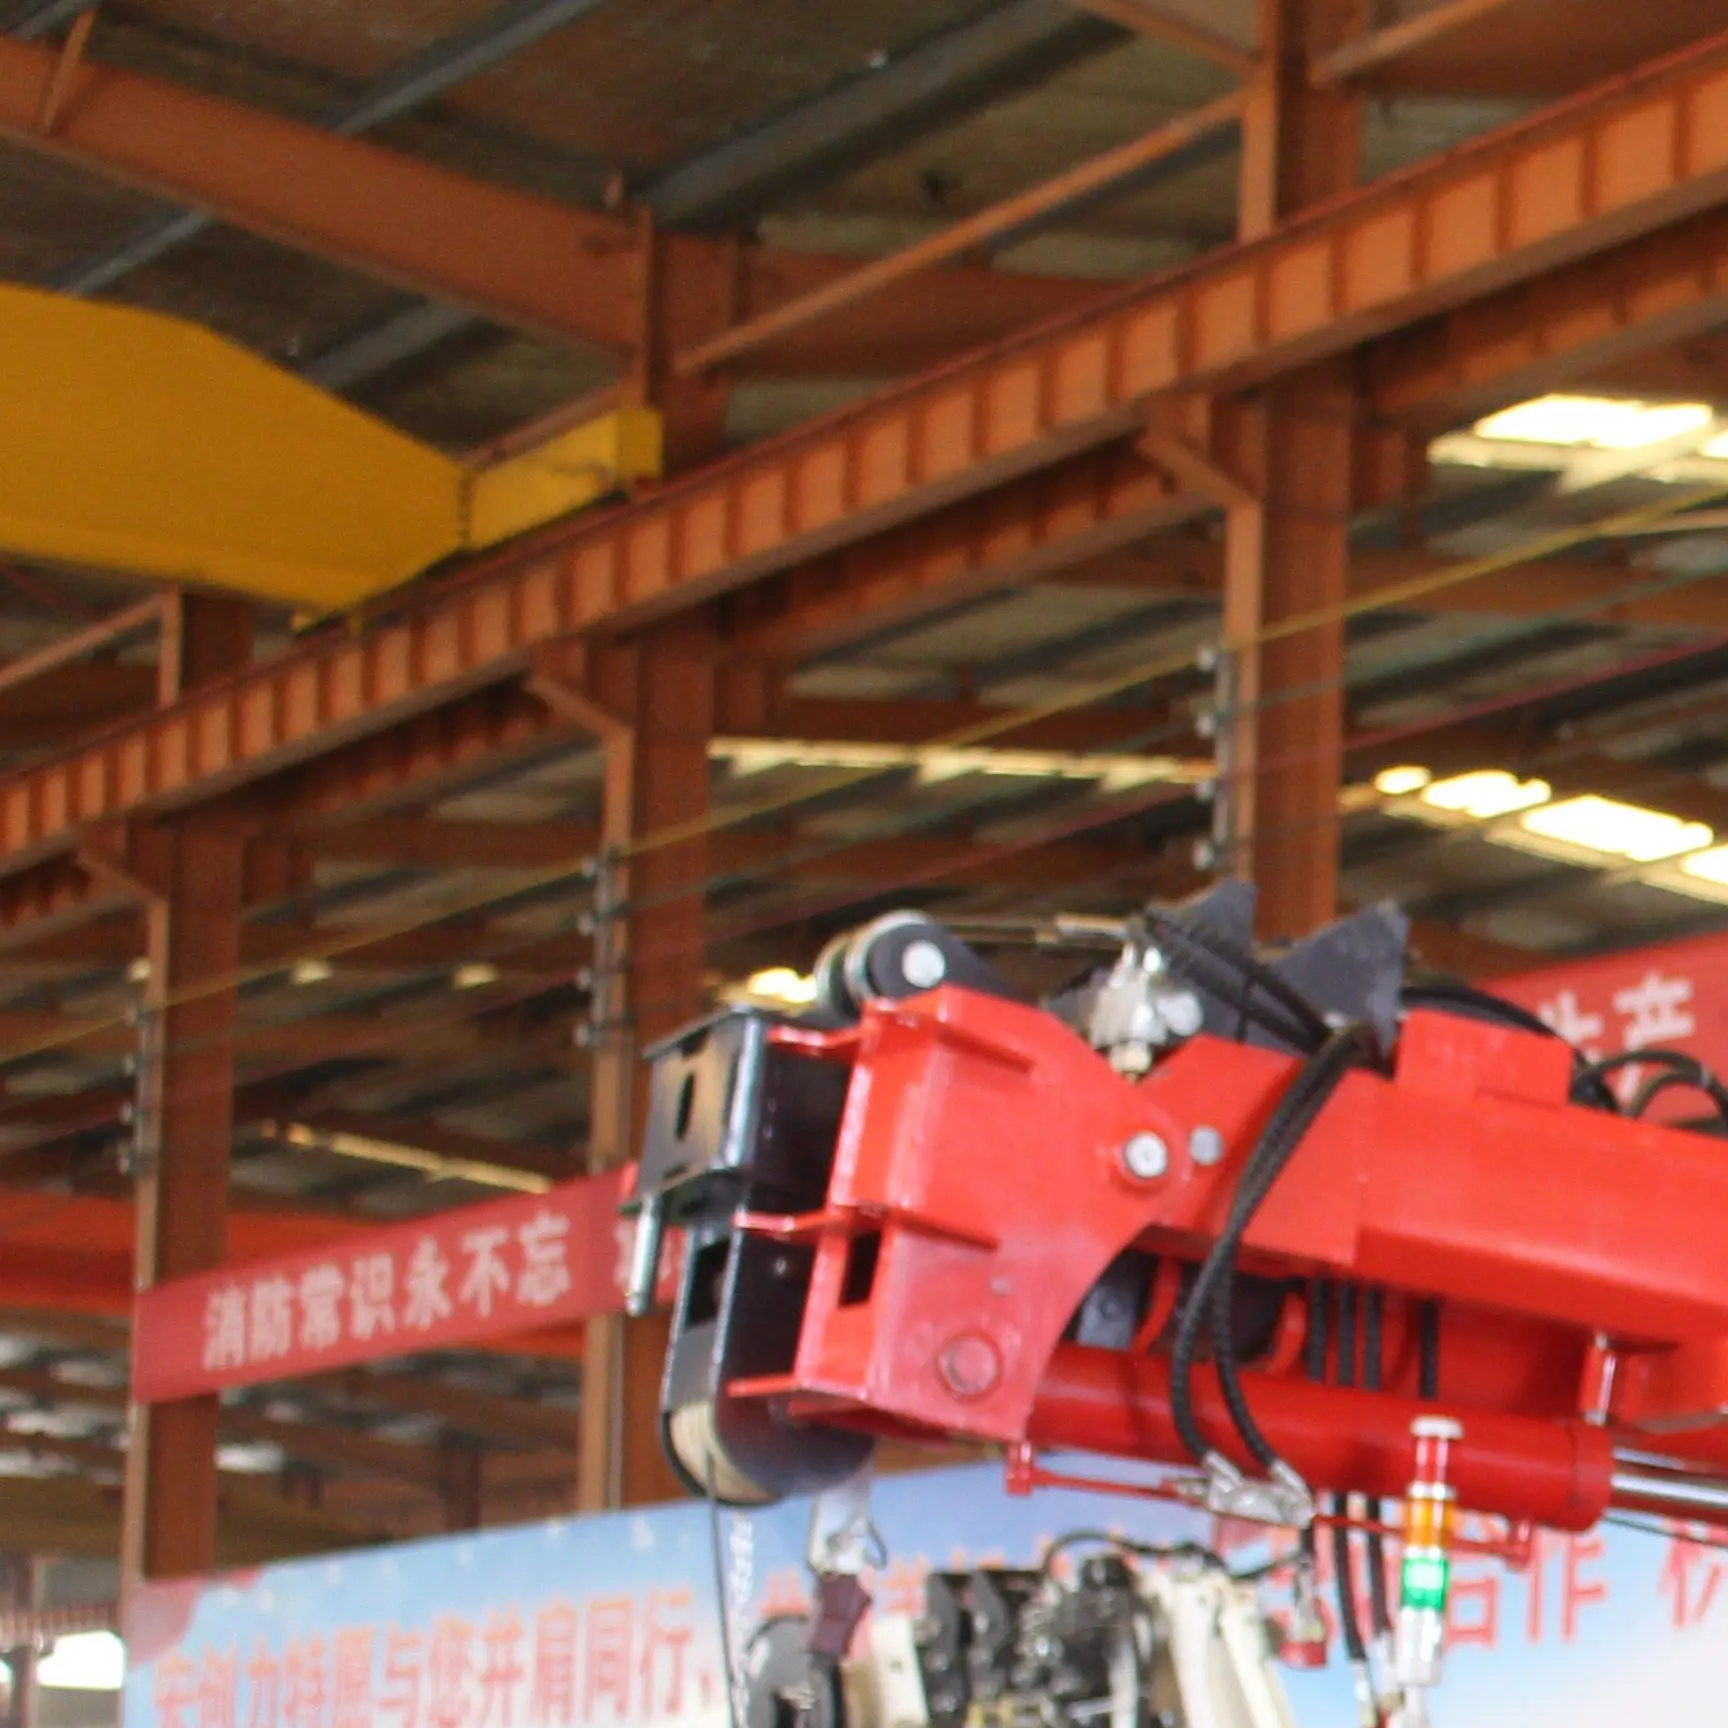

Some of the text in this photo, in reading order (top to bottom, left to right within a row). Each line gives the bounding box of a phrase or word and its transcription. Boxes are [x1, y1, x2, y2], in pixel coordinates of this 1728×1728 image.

[202, 1209, 571, 1372] 消防常识永不忘
